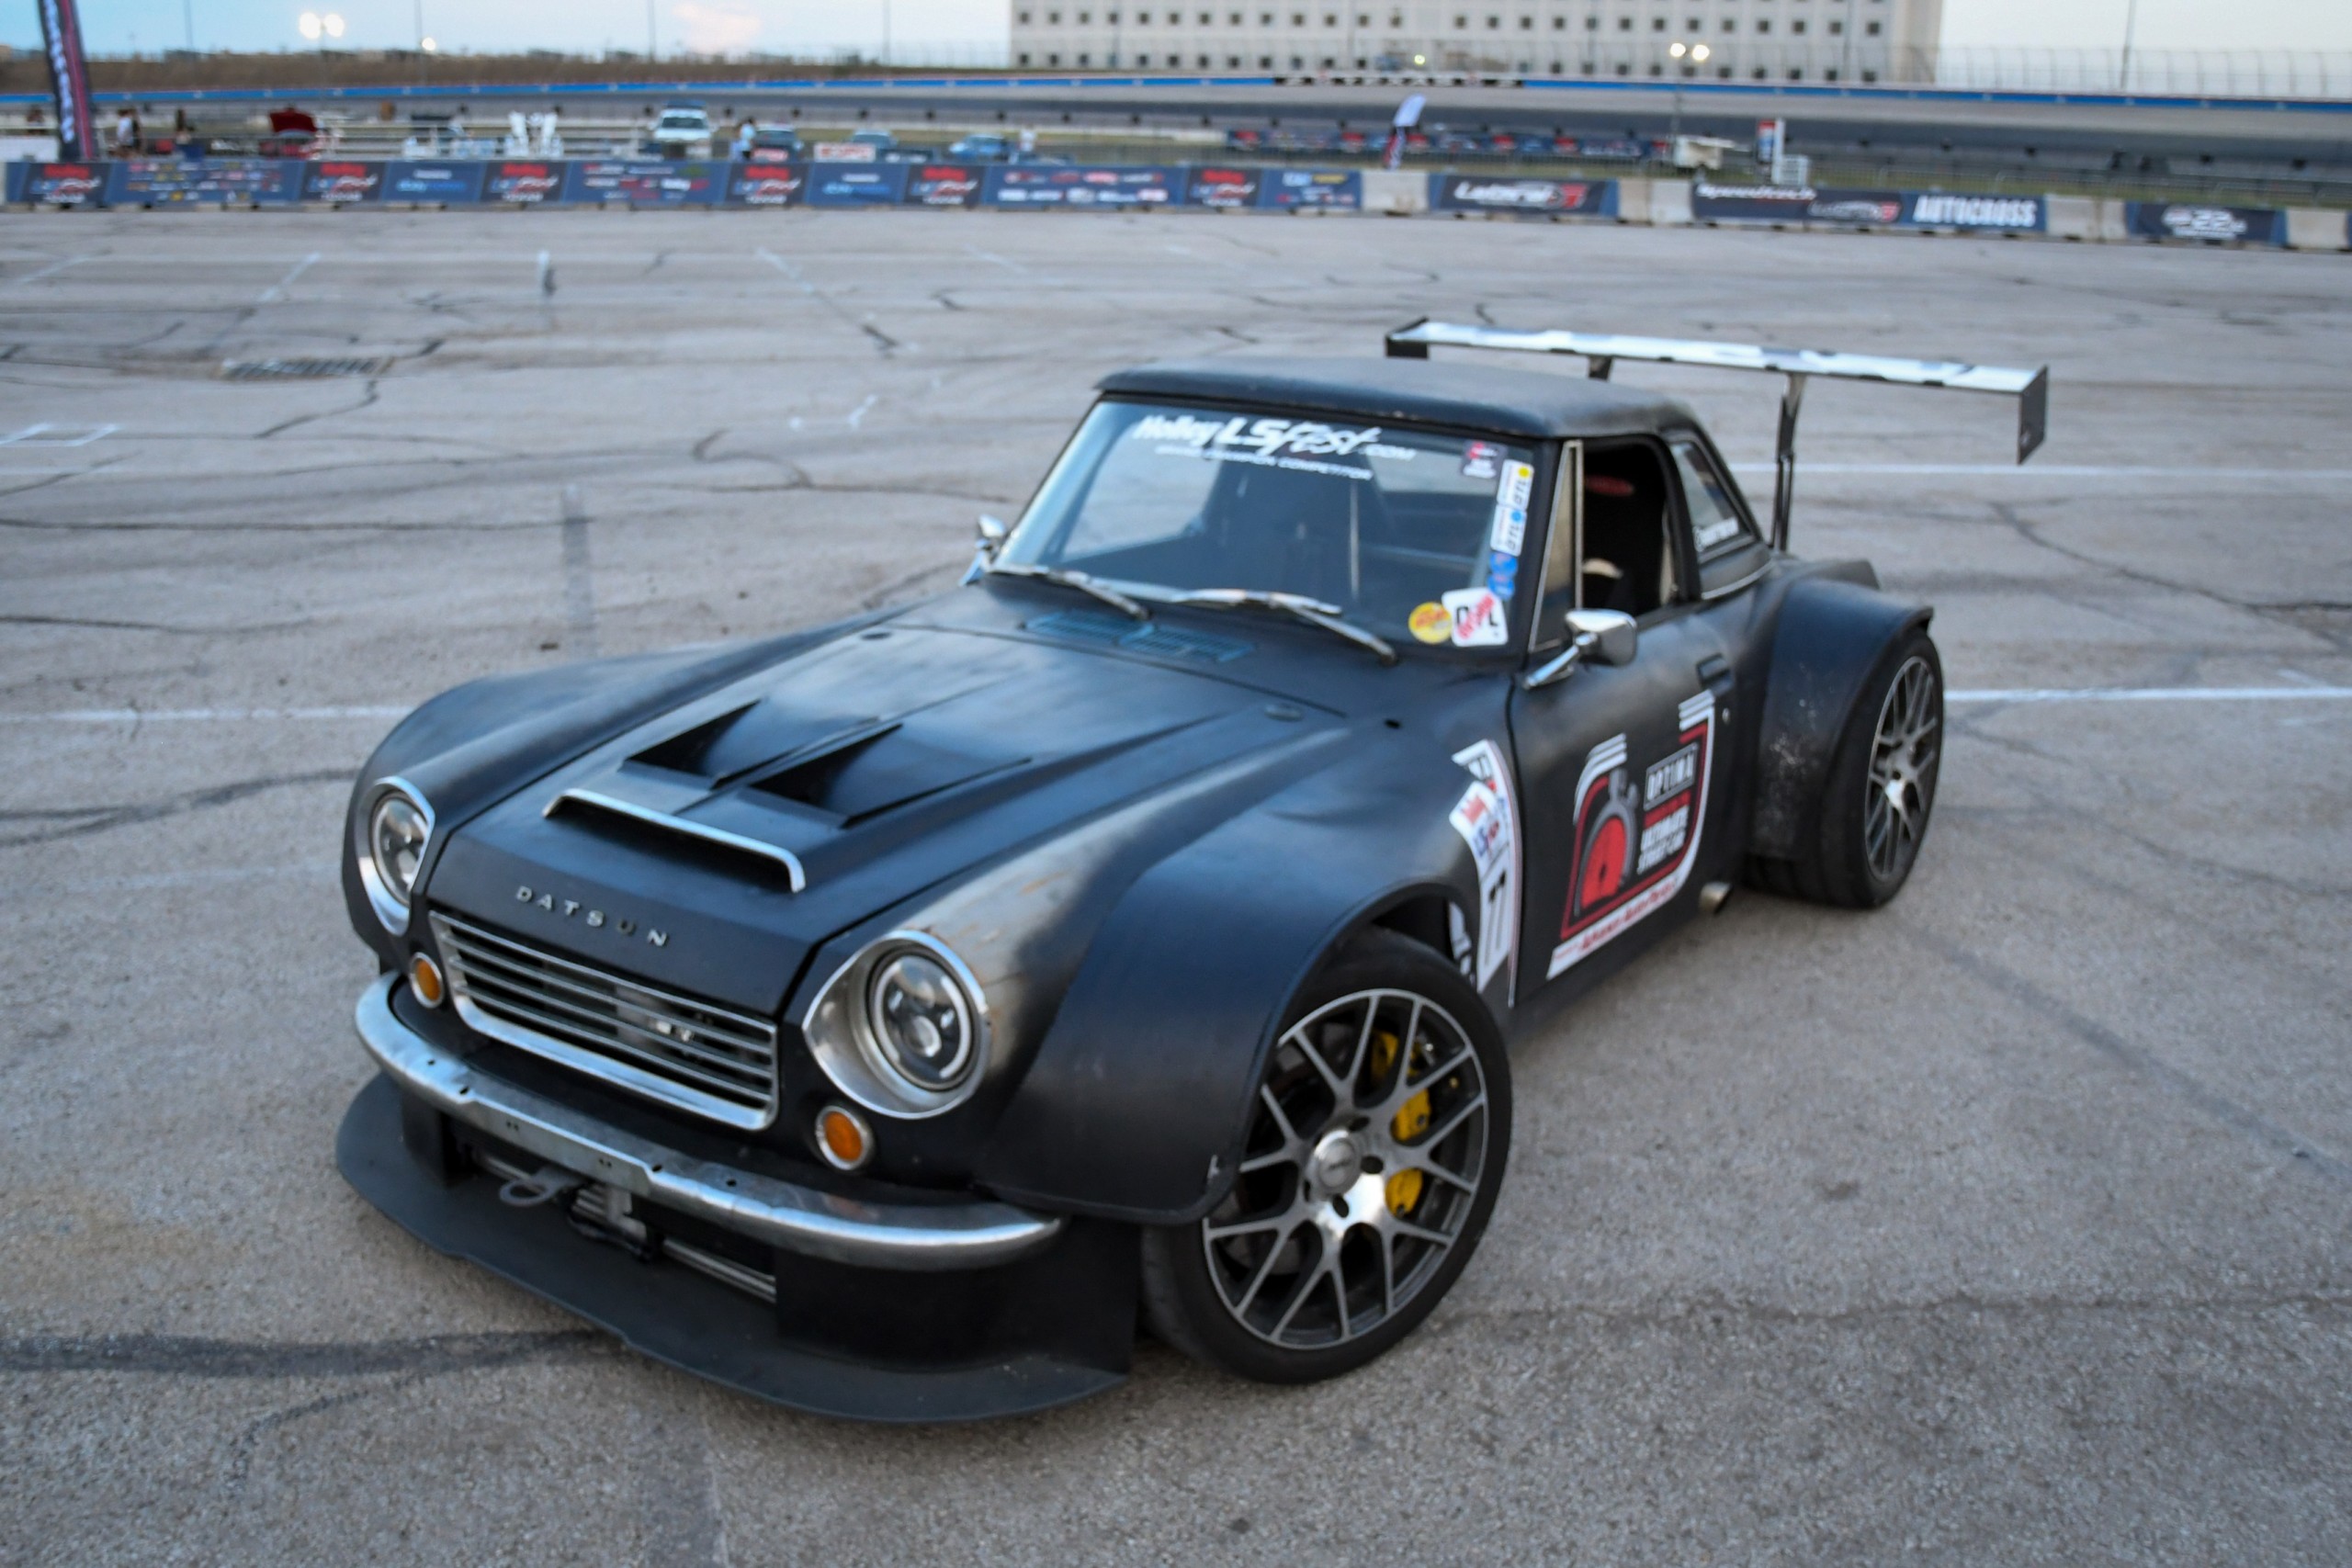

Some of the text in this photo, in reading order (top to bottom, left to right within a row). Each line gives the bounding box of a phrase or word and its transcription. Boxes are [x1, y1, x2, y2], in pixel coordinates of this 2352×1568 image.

[1913, 195, 2037, 227] AUTOCROSS
[1132, 414, 1225, 447] Holley
[1646, 751, 1694, 803] OPTIMA
[516, 886, 668, 947] DATSUN
